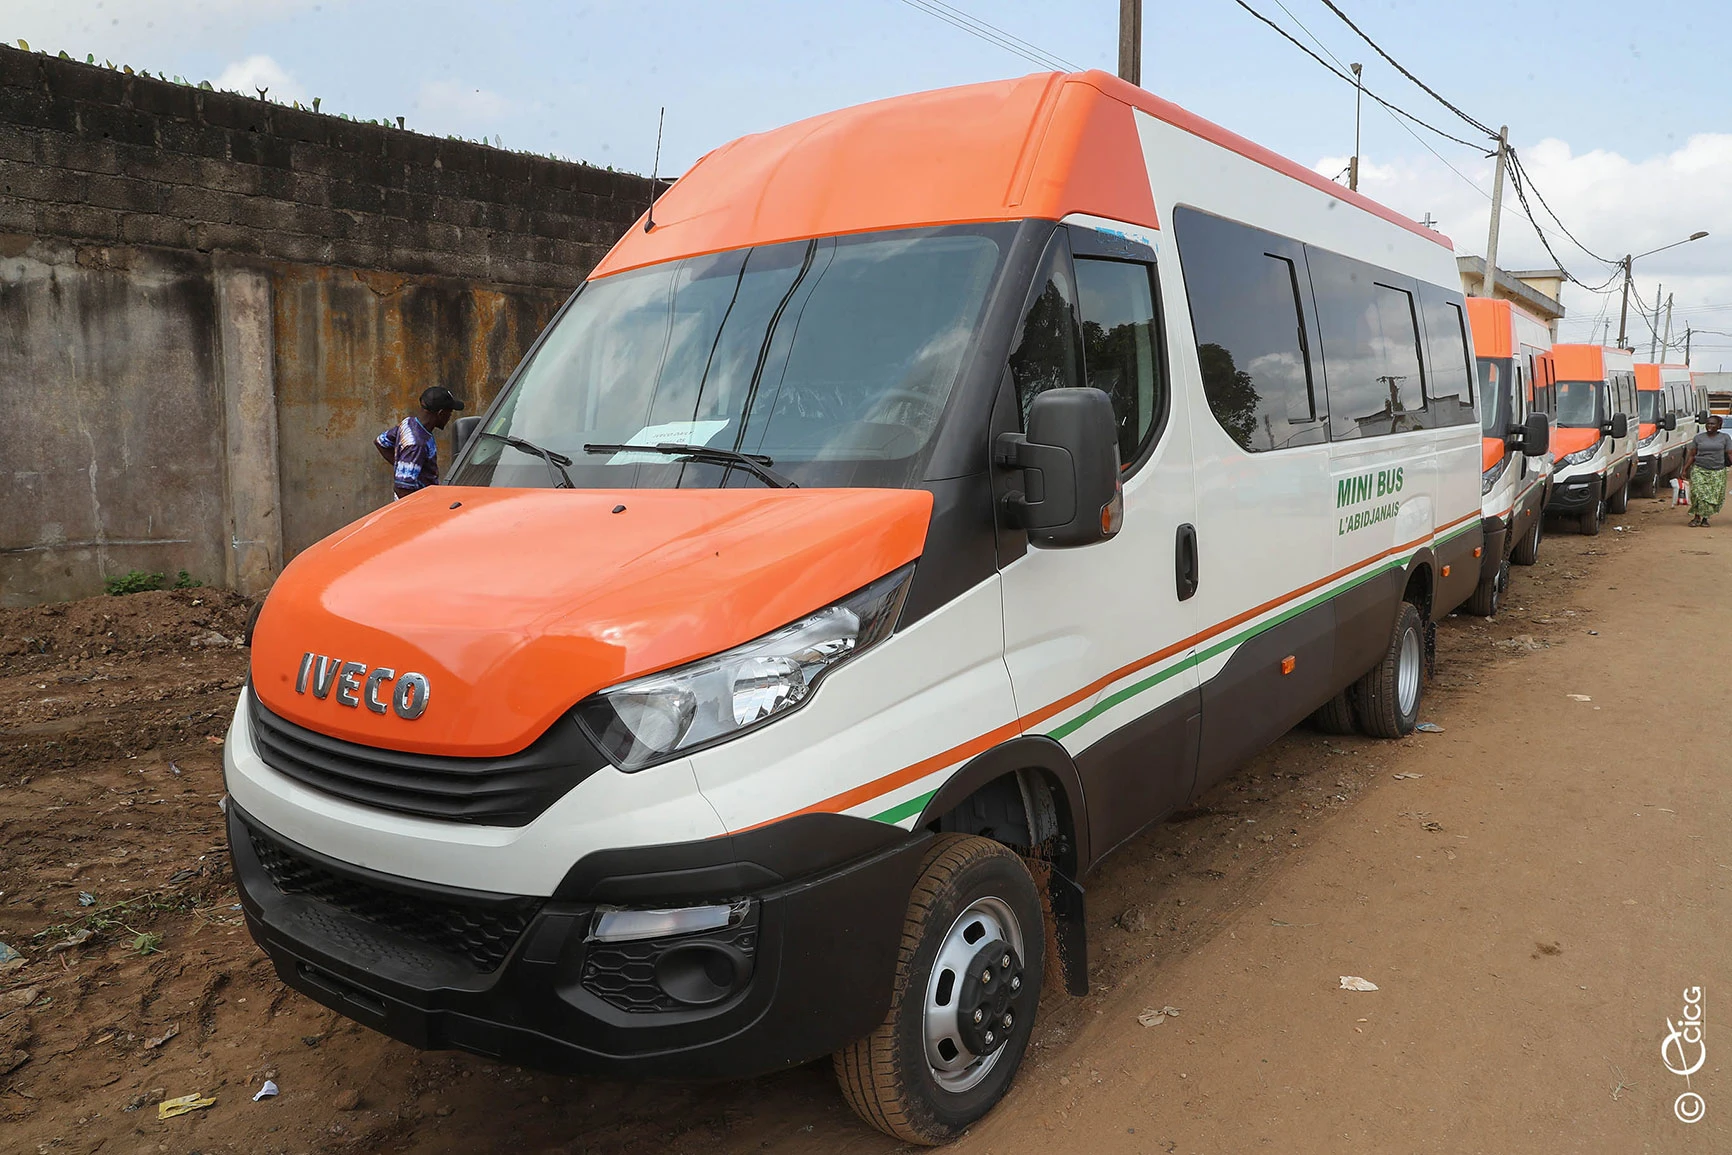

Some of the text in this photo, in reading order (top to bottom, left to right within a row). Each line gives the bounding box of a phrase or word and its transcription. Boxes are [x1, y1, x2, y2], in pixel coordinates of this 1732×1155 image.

[1337, 467, 1404, 508] MINI BUS
[1339, 501, 1400, 536] L'ABIDJANAIS
[295, 652, 431, 720] IVECO
